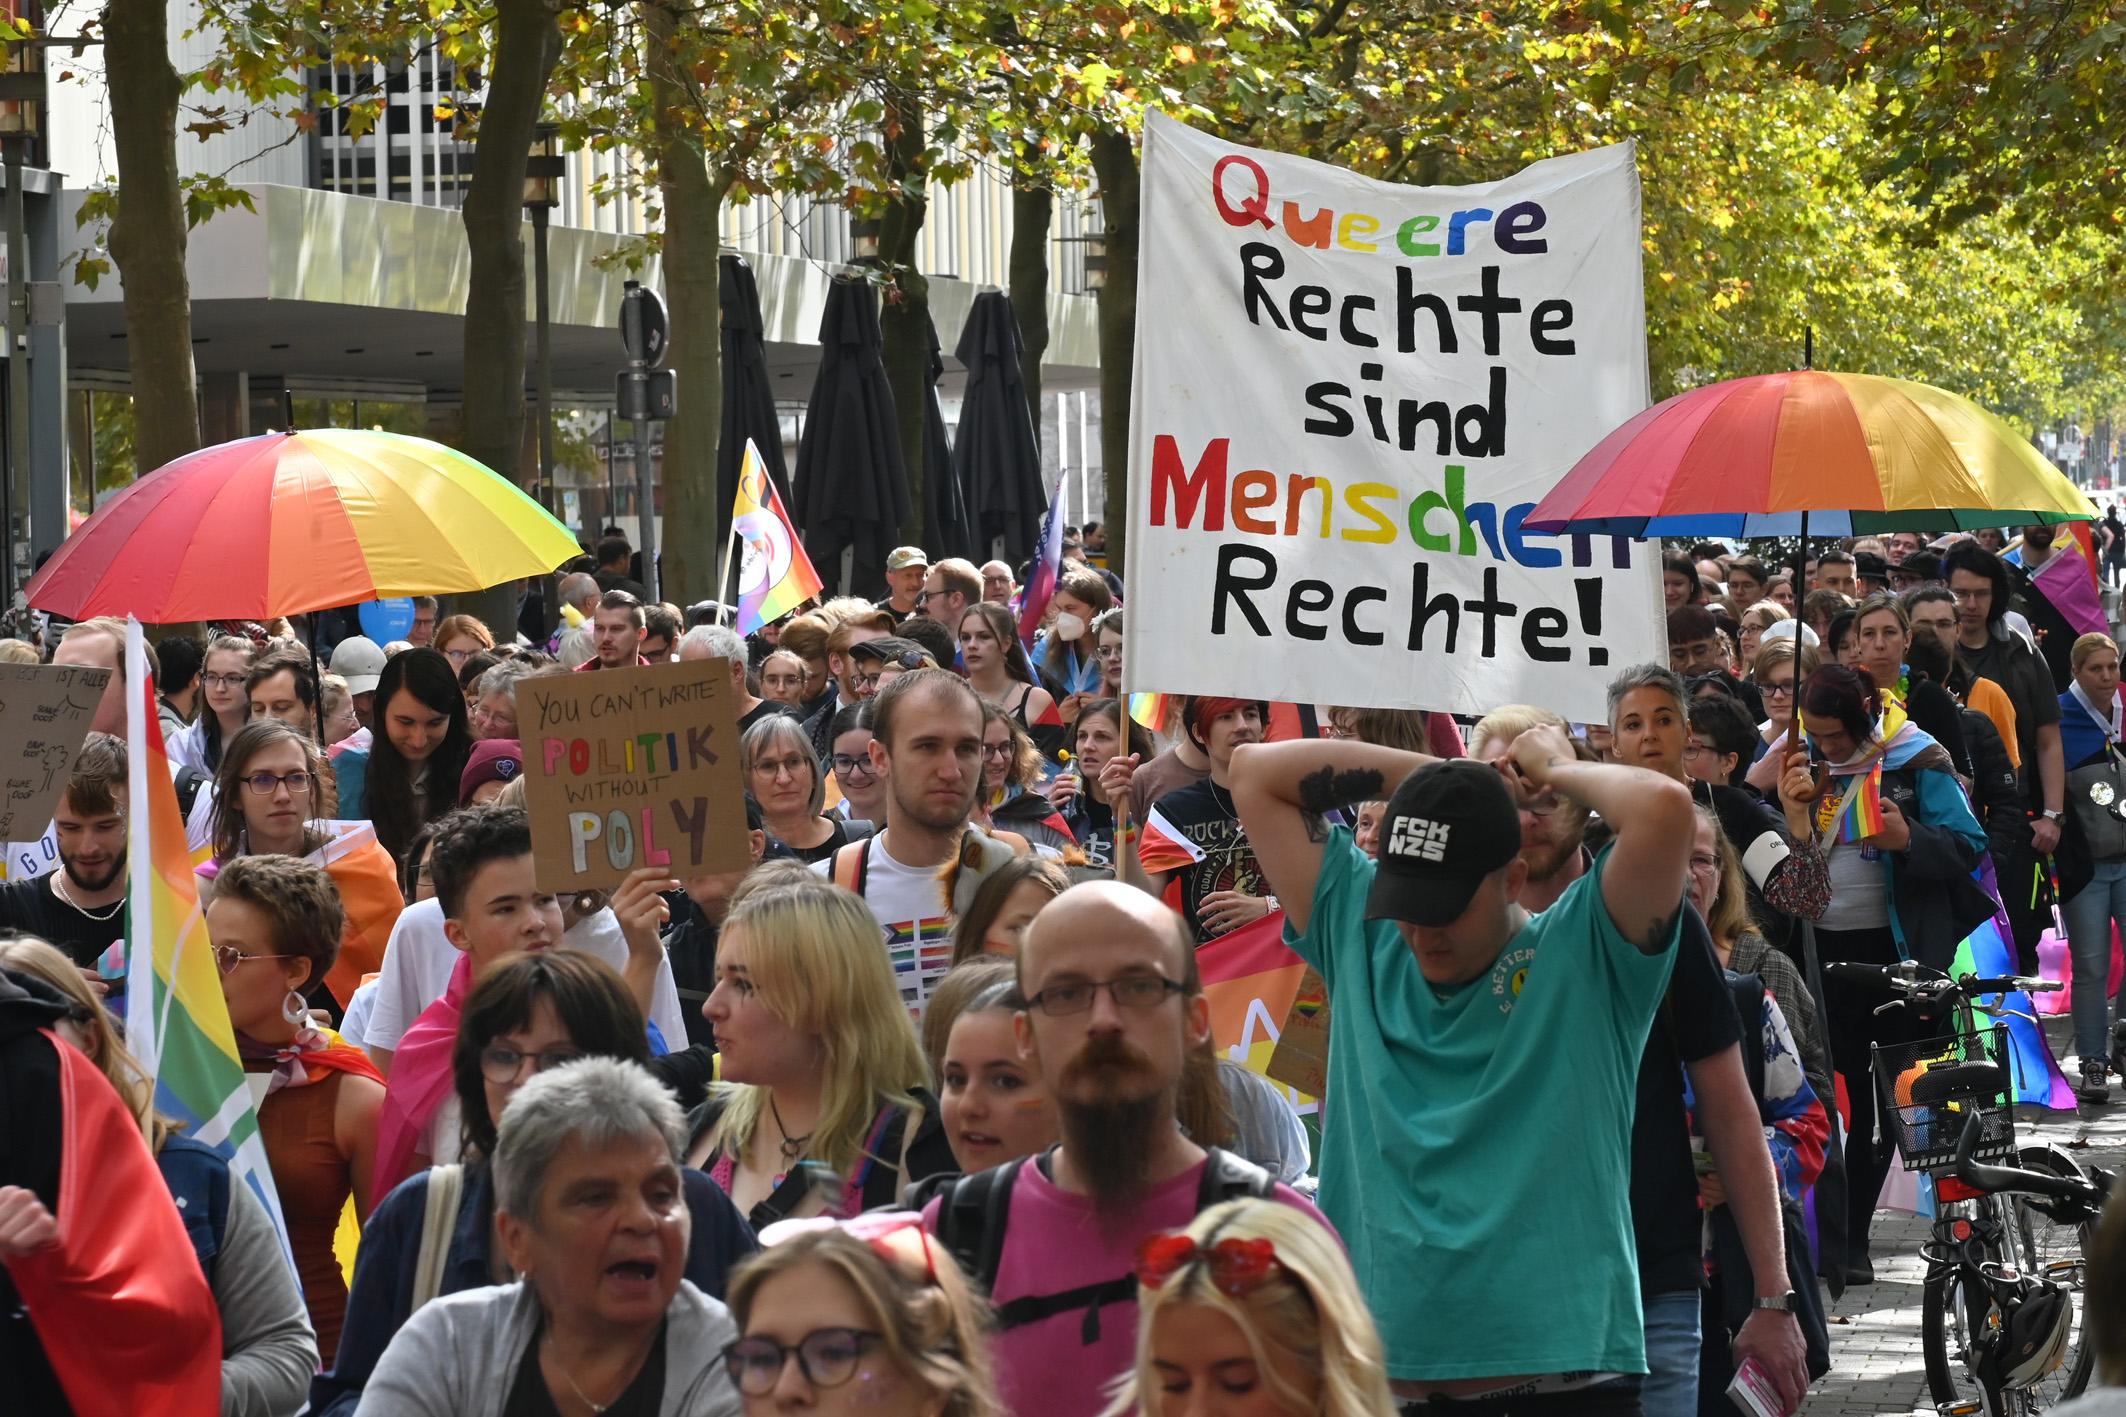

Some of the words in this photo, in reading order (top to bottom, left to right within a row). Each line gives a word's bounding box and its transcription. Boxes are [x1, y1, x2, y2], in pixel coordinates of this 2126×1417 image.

[1212, 154, 1549, 257] Queere
[1239, 241, 1577, 356] Rechte
[1304, 362, 1507, 459] sind
[1211, 543, 1609, 666] Rechte!
[56, 669, 78, 688] IST
[534, 691, 580, 730] YOU
[590, 685, 655, 719] CAN'T
[658, 678, 719, 708] WRITE
[543, 724, 720, 776] POLITIK
[564, 775, 671, 804] WITHOUT
[568, 796, 709, 875] POLY
[1388, 834, 1447, 862] NZS
[1392, 815, 1451, 843] FCK
[1200, 866, 1214, 895] TODAY
[1492, 948, 1537, 995] BETTER
